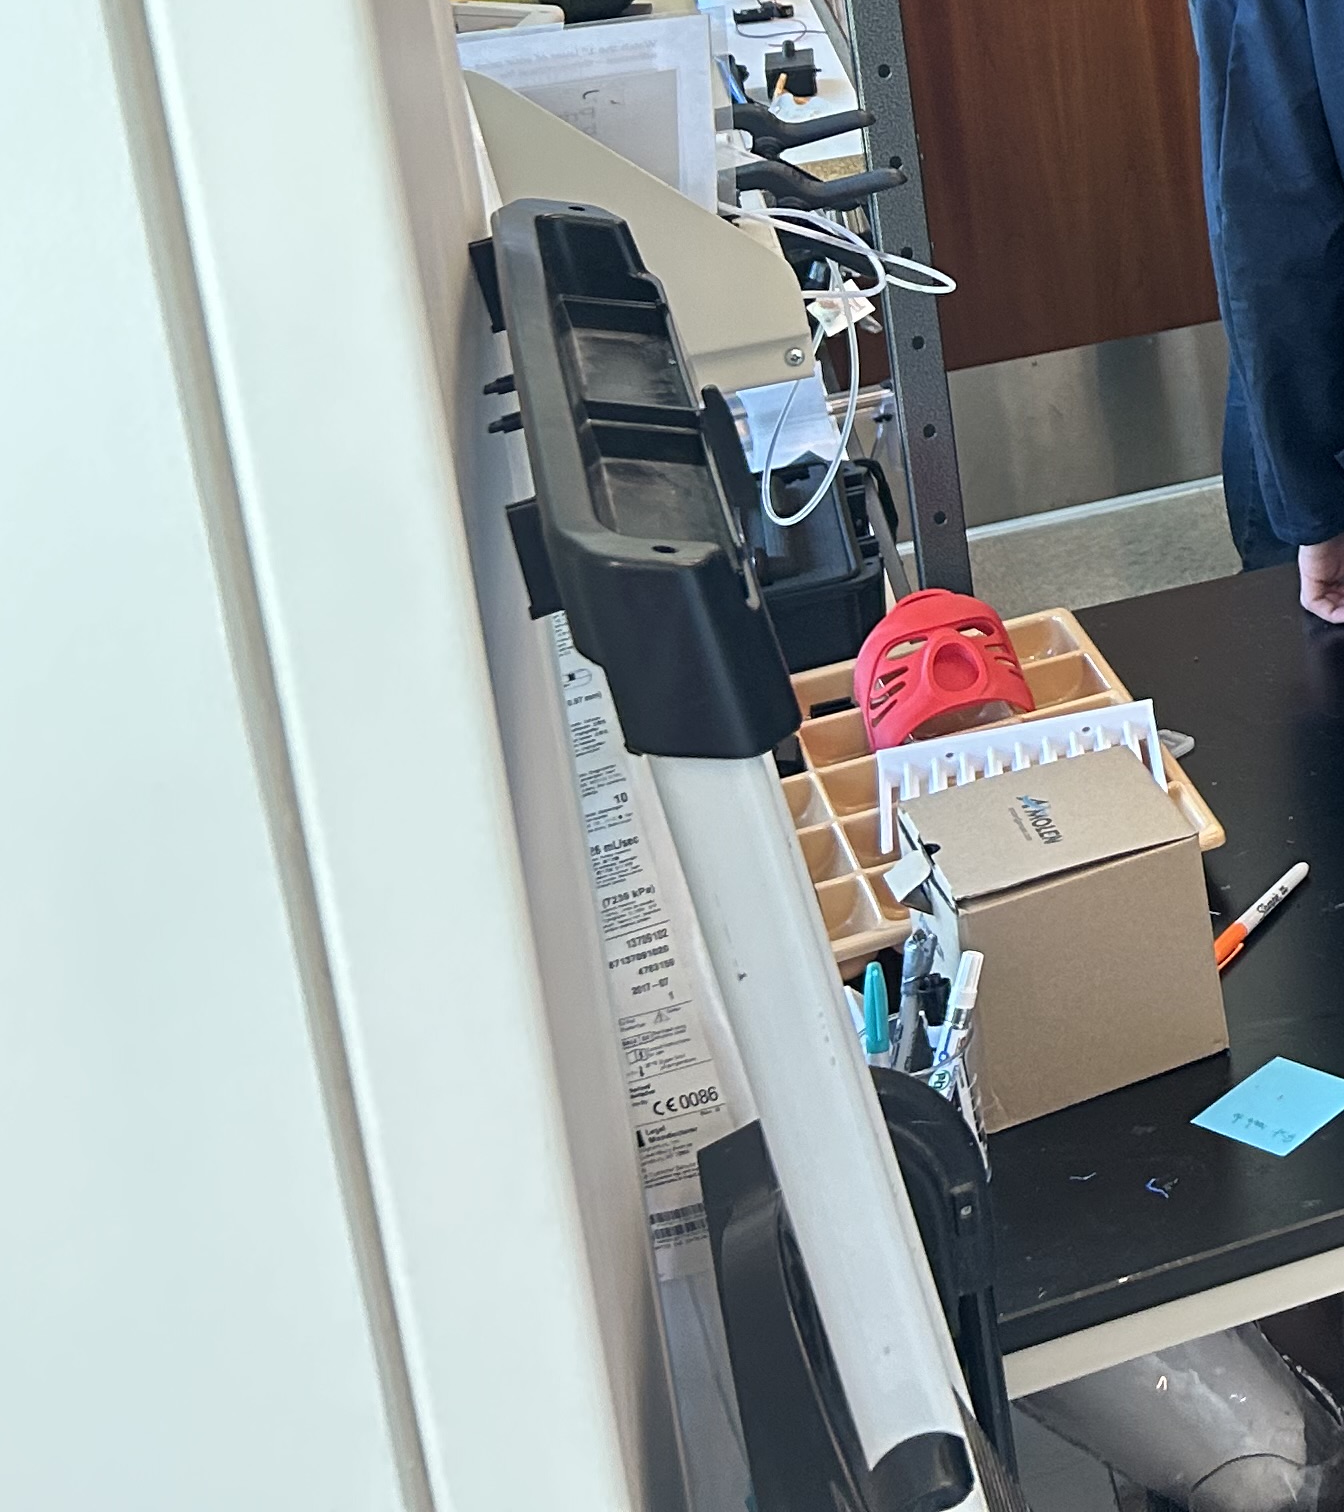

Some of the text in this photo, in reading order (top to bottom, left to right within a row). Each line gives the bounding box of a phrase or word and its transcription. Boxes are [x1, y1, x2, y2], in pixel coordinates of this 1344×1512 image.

[613, 791, 628, 804] 10
[603, 836, 640, 854] mL/sec
[632, 884, 656, 899] kPa)
[679, 1086, 719, 1109] 0086
